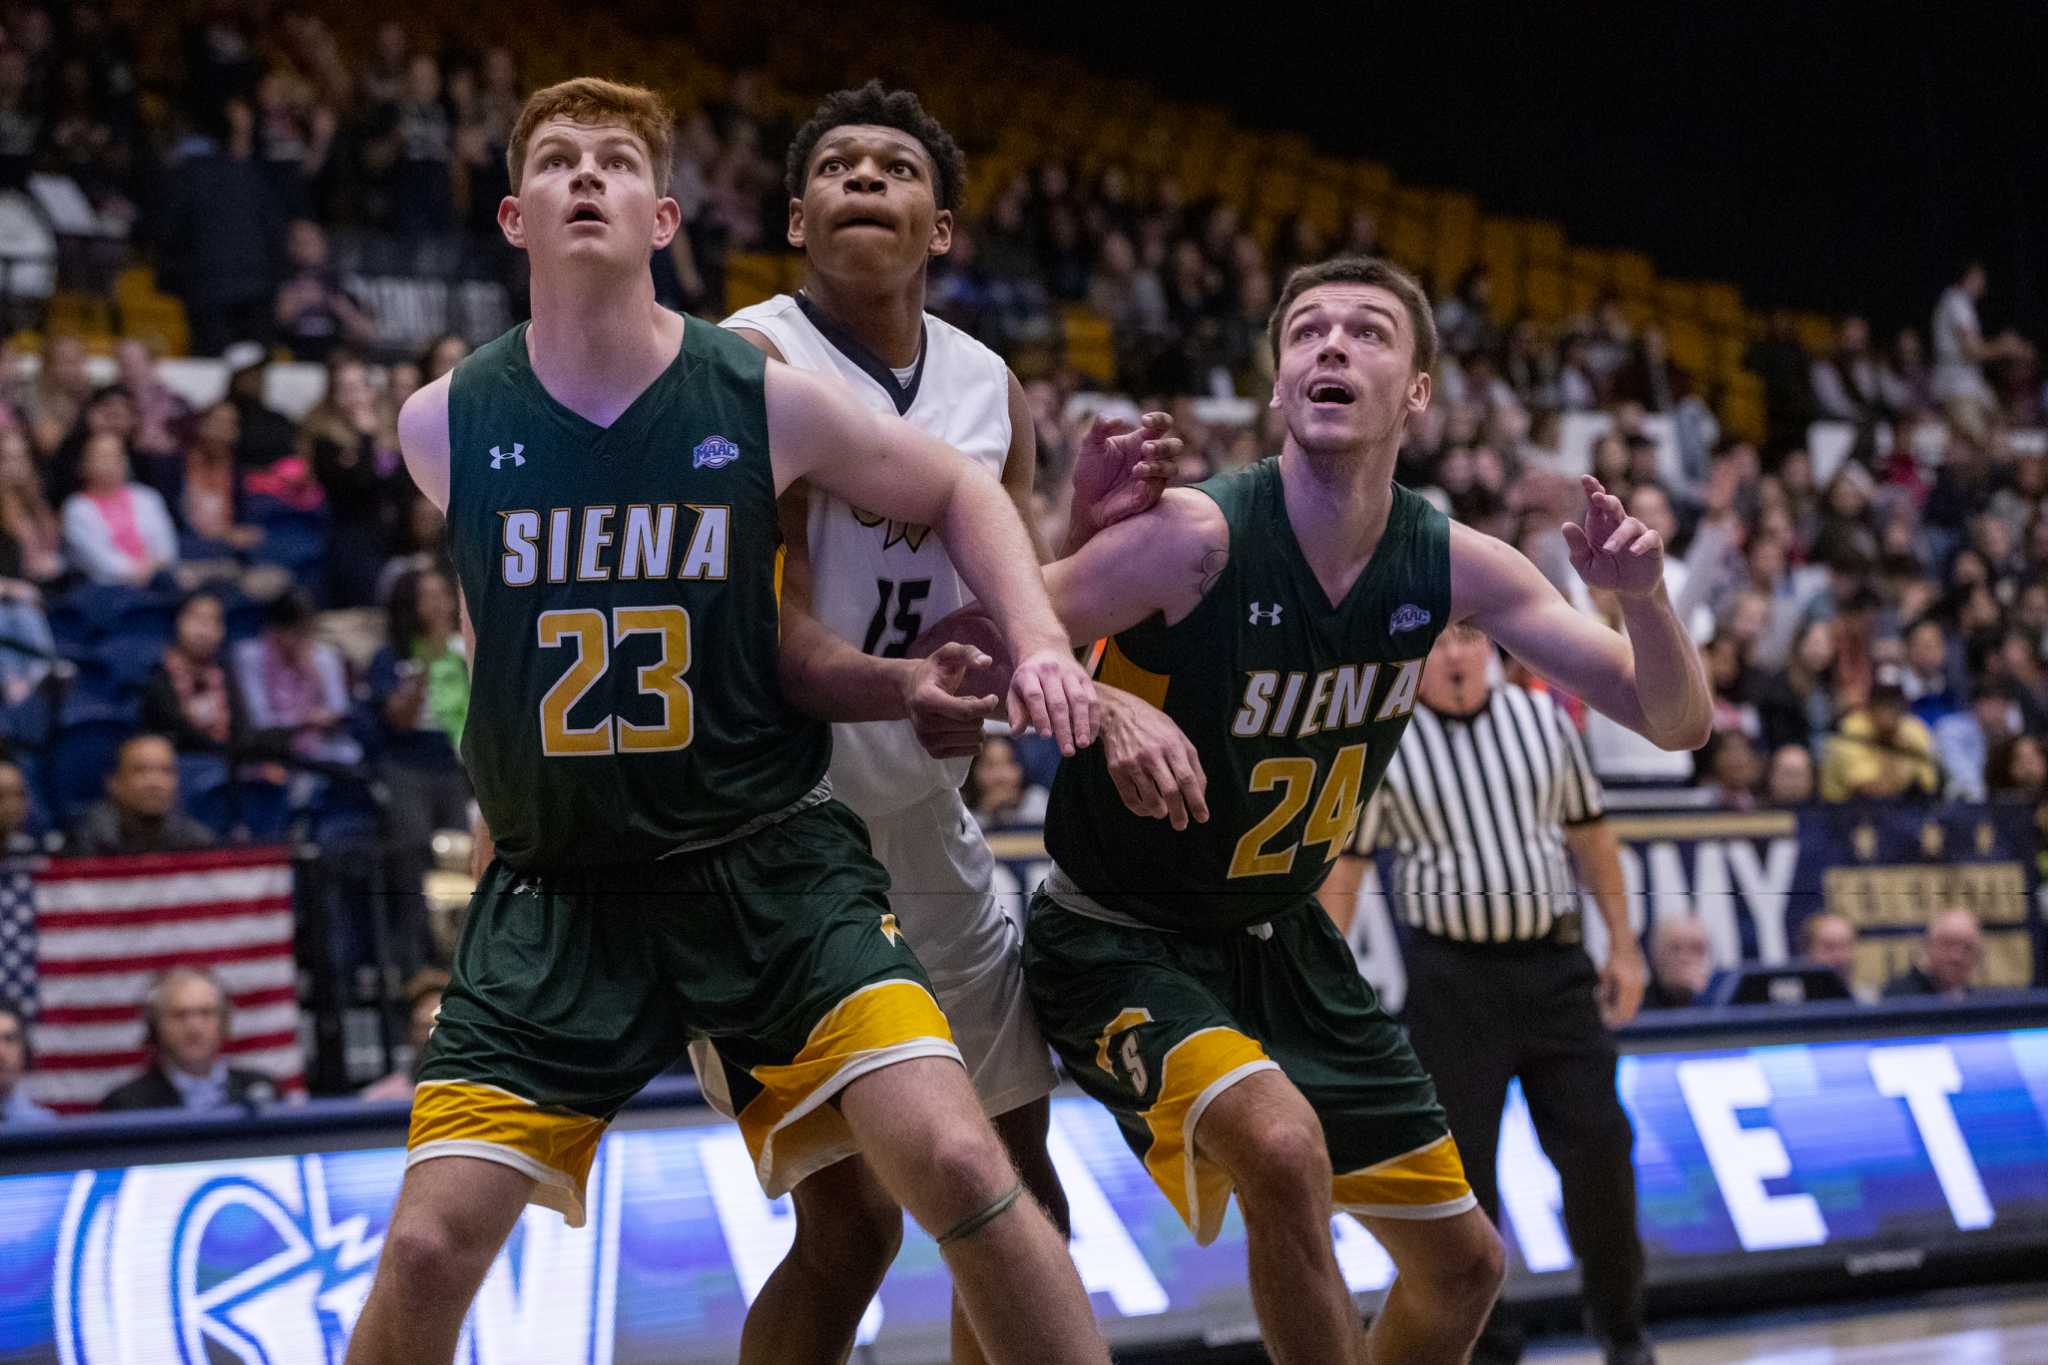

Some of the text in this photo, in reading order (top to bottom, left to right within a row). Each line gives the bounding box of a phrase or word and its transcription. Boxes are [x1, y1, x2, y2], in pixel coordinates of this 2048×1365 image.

[693, 436, 739, 468] MAAC
[496, 503, 730, 587] SIENA
[862, 578, 932, 658] 15
[537, 605, 694, 756] 23
[1231, 657, 1425, 739] SIENA
[1227, 743, 1367, 879] 24
